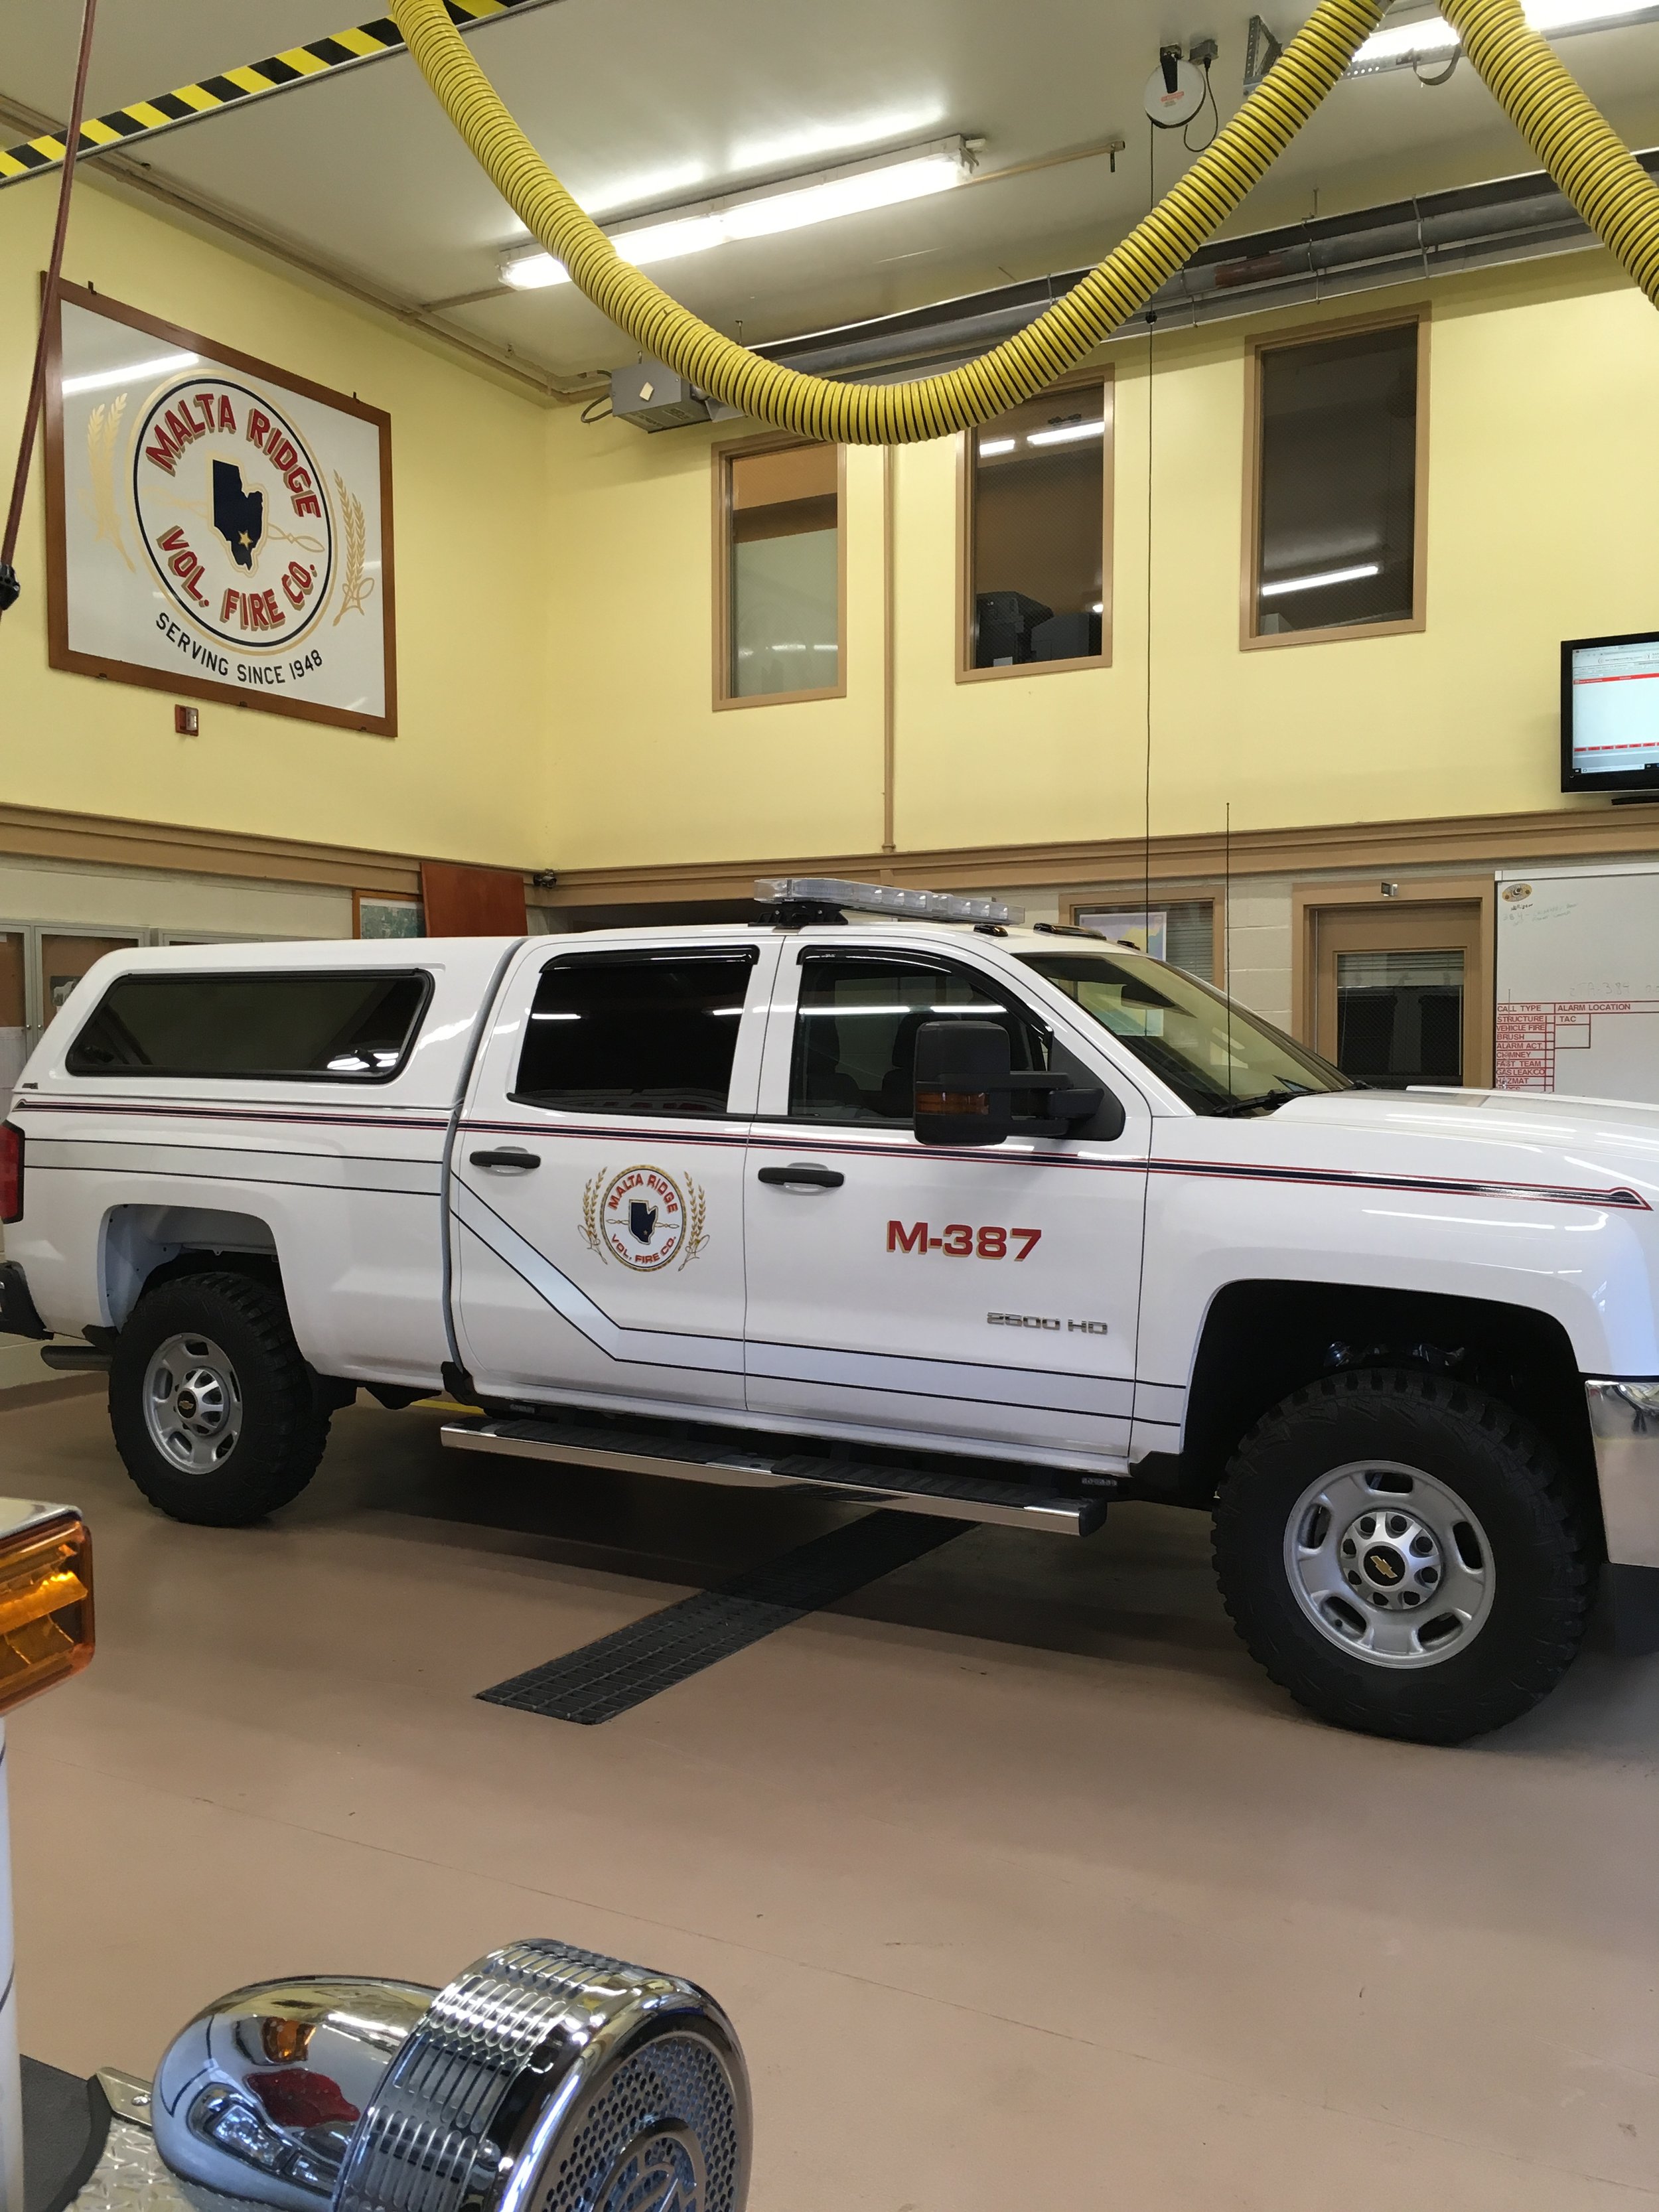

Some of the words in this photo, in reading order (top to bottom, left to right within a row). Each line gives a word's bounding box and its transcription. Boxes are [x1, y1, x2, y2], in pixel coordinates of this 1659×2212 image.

[145, 392, 237, 477] MALTA
[246, 407, 322, 518] RIDGE
[156, 525, 210, 607] VOL.
[220, 587, 286, 631] FIRE
[281, 560, 319, 610] CO.
[155, 611, 229, 676] SERVING
[237, 664, 285, 685] SINCE
[289, 650, 323, 681] 1948
[608, 1173, 644, 1211] MALTA
[646, 1173, 679, 1215] RIDGE
[634, 1252, 661, 1264] FIRE
[886, 1220, 1043, 1262] M-387
[987, 1311, 1061, 1331] 2500
[1067, 1318, 1109, 1335] HD
